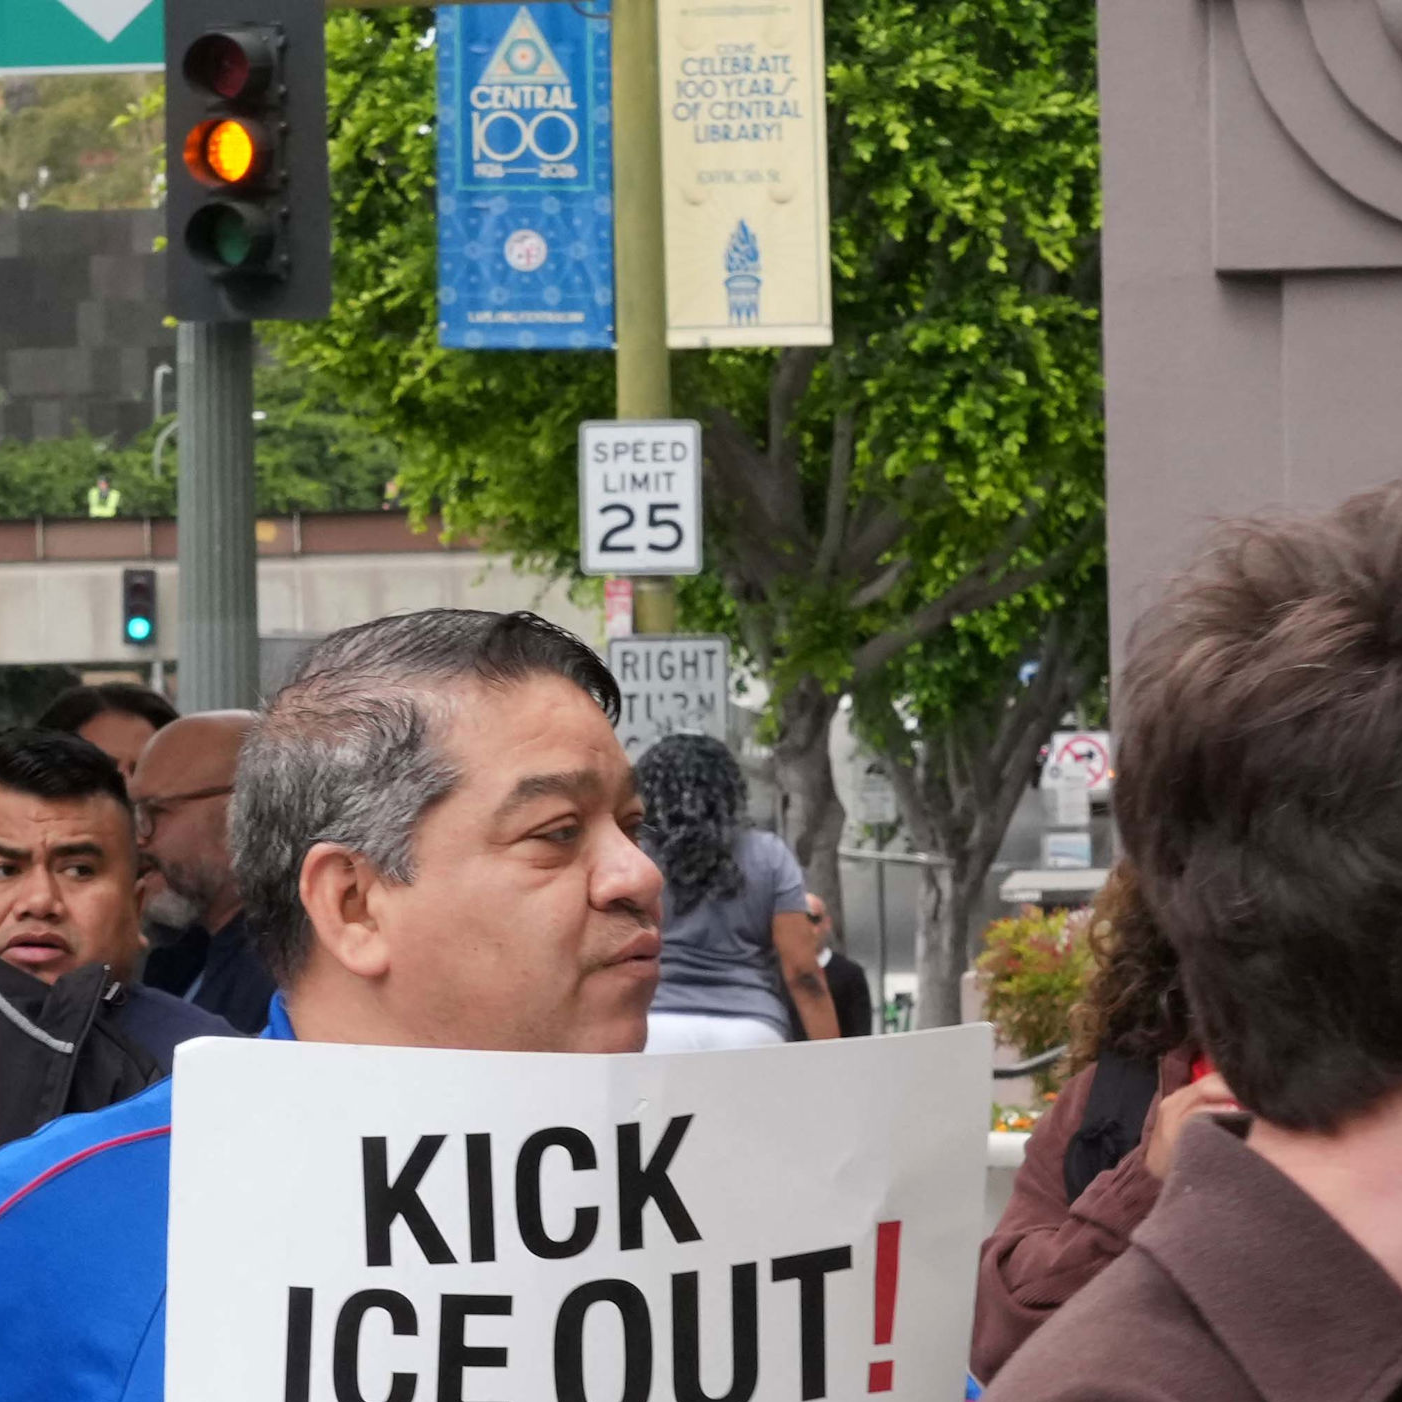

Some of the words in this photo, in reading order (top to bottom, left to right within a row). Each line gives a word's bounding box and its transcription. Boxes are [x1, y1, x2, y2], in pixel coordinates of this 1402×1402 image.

[681, 55, 792, 76] CELEBRATE
[470, 85, 578, 109] CENTRAL
[675, 79, 717, 98] 100
[720, 77, 799, 97] YEARS
[672, 102, 701, 121] OF
[709, 100, 804, 120] CENTRAL
[471, 110, 579, 162] 100
[694, 123, 783, 144] LIBRARY!
[593, 440, 688, 463] SPEED
[603, 472, 675, 493] LIMIT
[599, 503, 684, 553] 25
[621, 649, 718, 681] RIGHT
[360, 1113, 703, 1268] KICK
